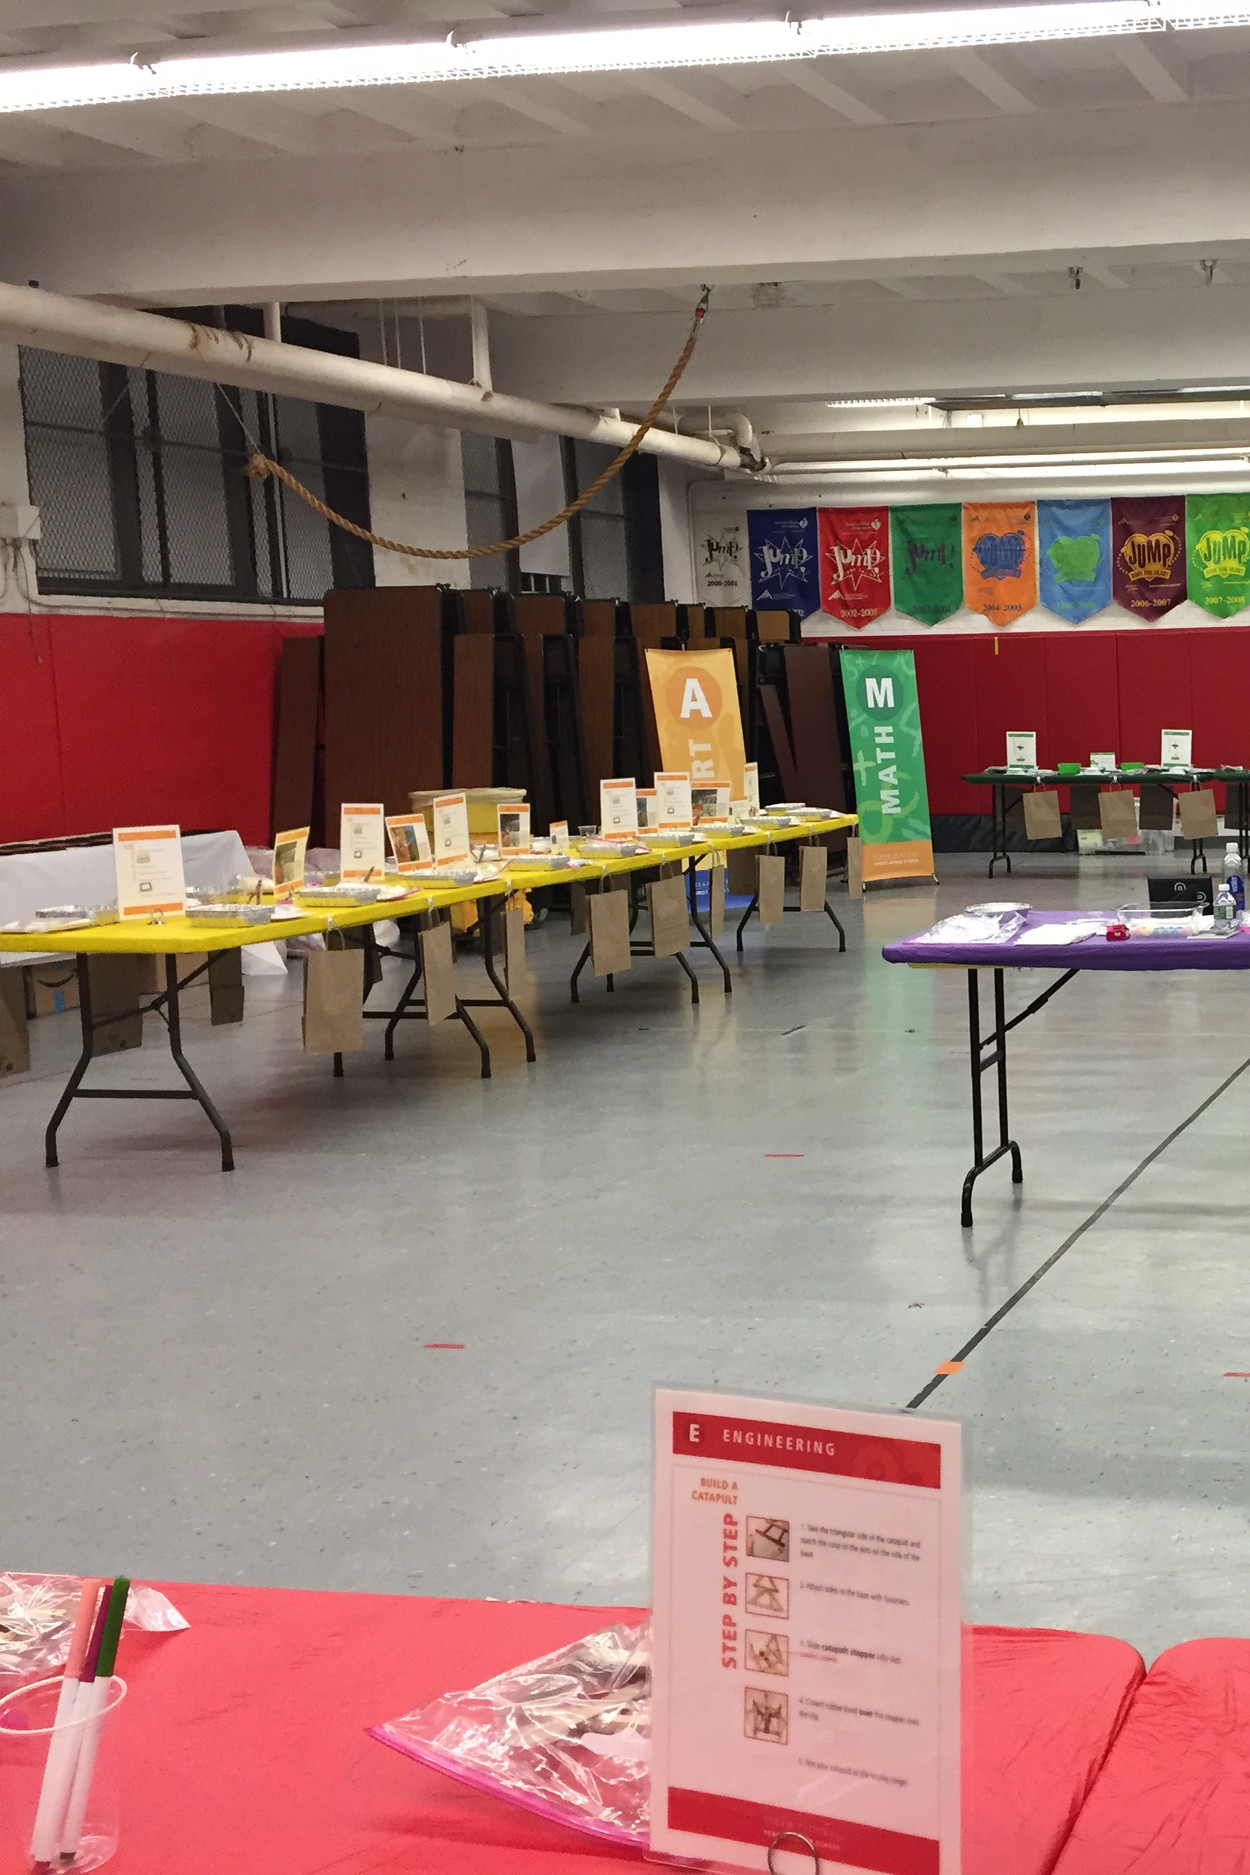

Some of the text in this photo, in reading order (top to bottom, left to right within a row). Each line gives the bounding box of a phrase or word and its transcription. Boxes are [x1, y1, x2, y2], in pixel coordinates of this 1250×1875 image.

[1128, 539, 1172, 568] JUMP
[1203, 535, 1247, 564] JUMP
[1130, 599, 1171, 608] 2006-2007
[1205, 596, 1246, 605] 2007-2008
[680, 678, 712, 718] A
[865, 678, 894, 708] M
[689, 738, 715, 779] RT
[874, 725, 901, 814] MATH
[688, 1423, 836, 1457] E ENGINEERING
[691, 1490, 738, 1505] CATAPULT
[700, 1477, 738, 1490] BUILD A
[722, 1512, 738, 1669] STEP BY STEP
